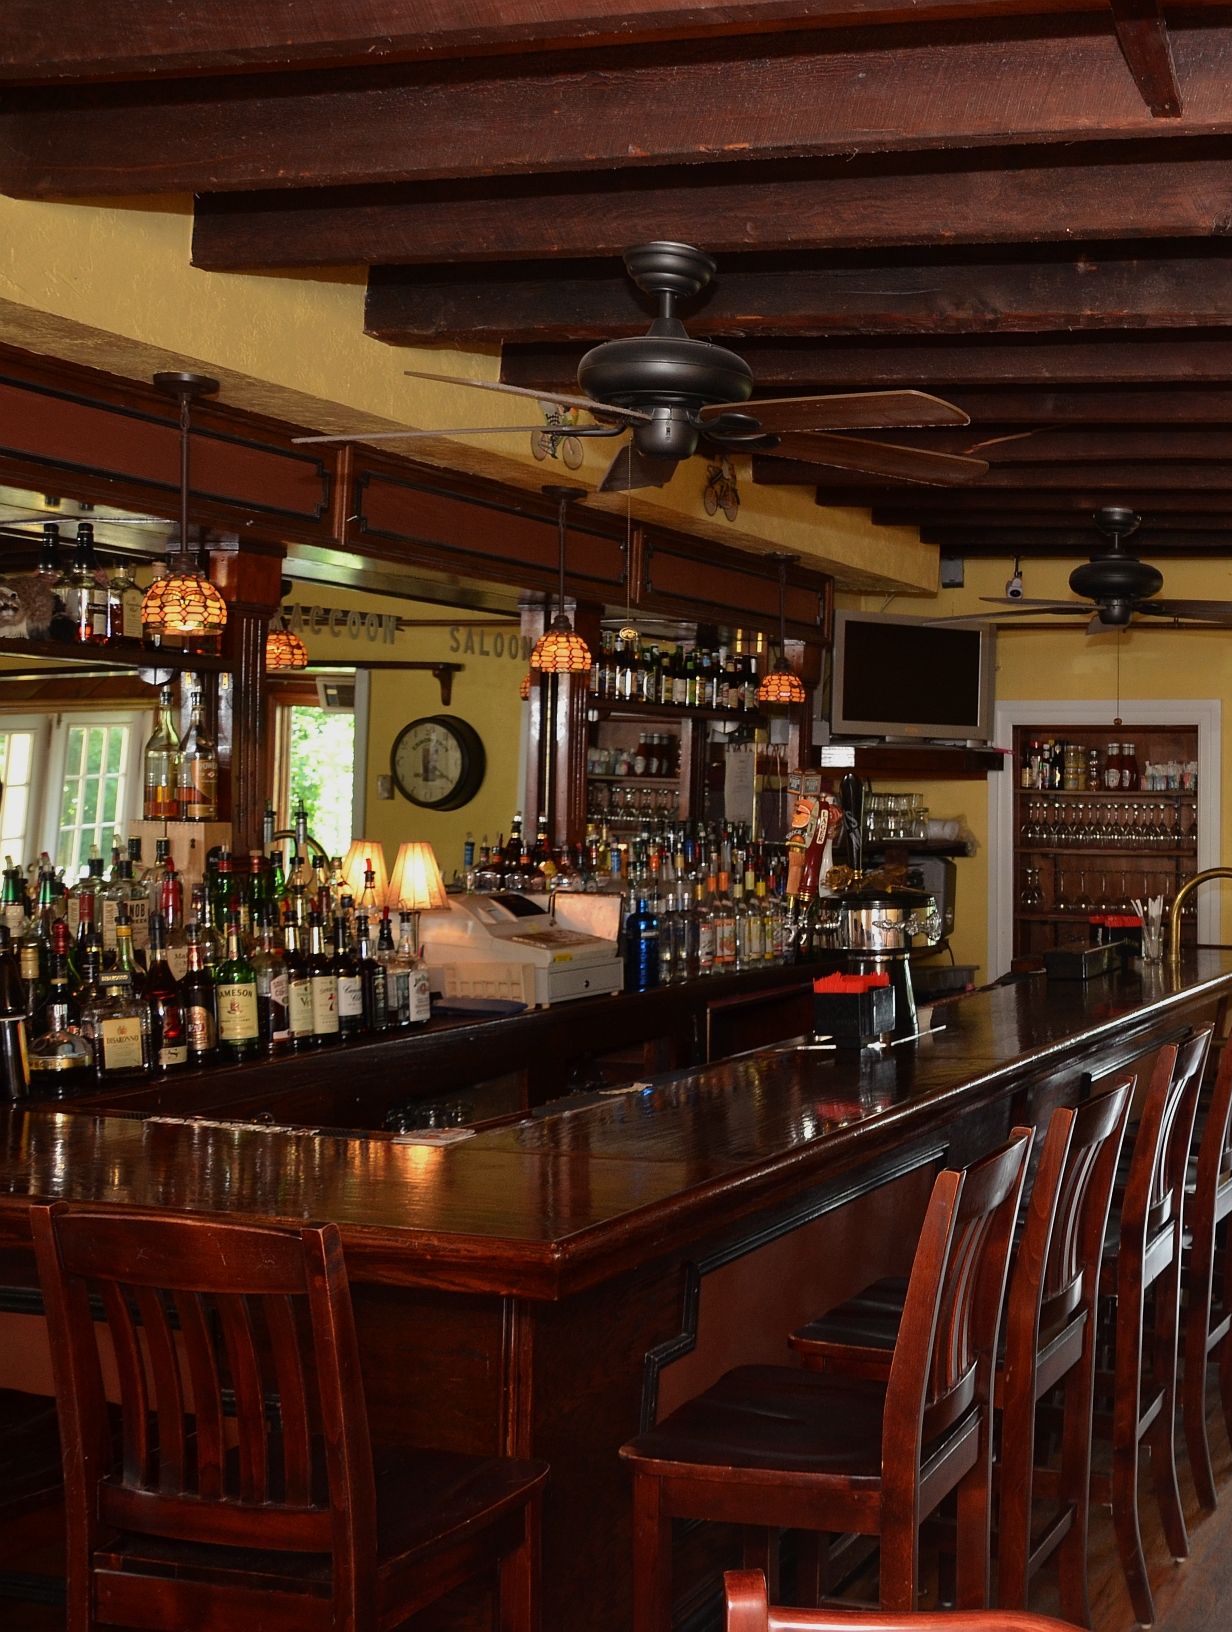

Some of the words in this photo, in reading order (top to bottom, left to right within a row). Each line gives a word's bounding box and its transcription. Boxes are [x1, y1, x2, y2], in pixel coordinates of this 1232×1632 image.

[450, 626, 532, 661] SALOON
[129, 903, 145, 917] NOB
[106, 1034, 139, 1044] DISARONNO
